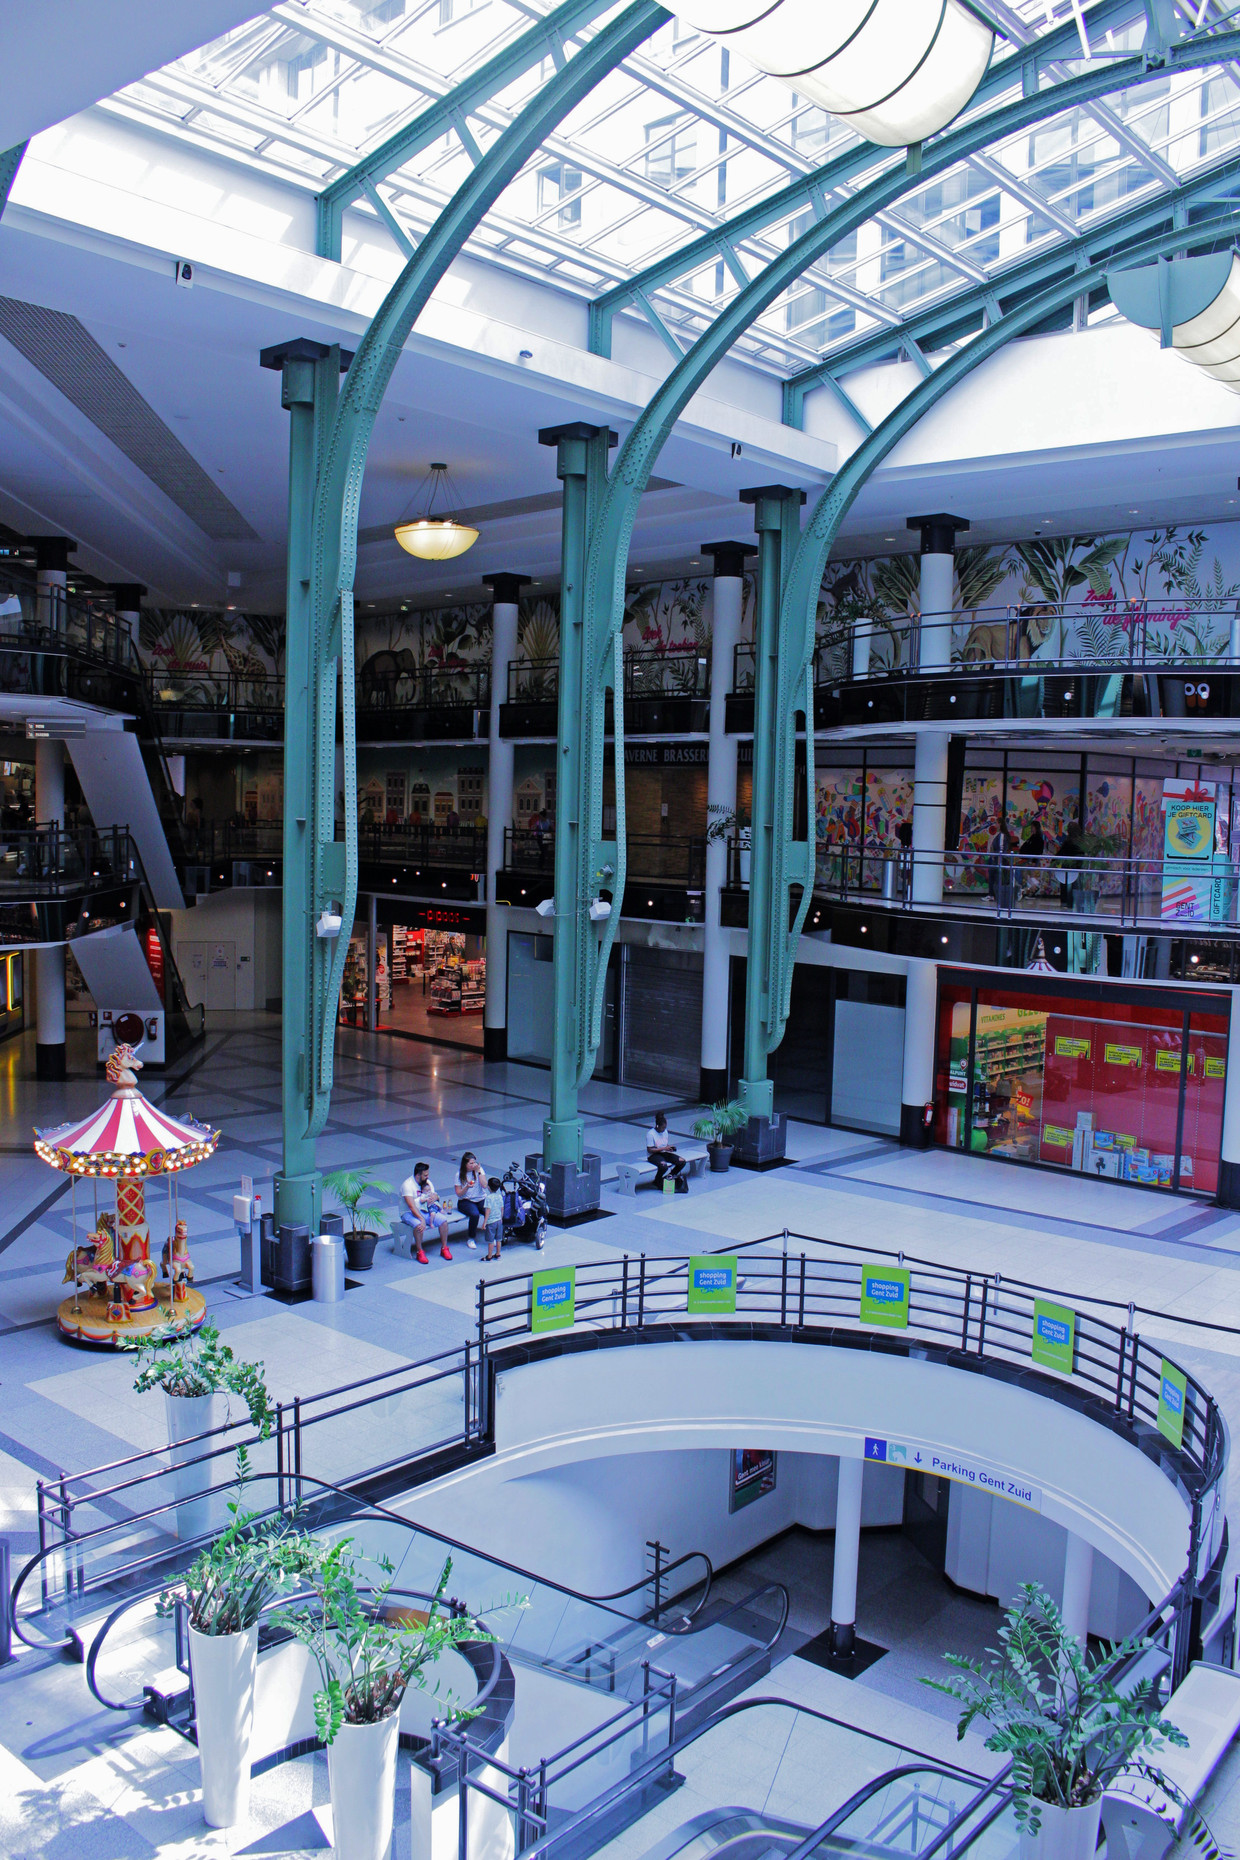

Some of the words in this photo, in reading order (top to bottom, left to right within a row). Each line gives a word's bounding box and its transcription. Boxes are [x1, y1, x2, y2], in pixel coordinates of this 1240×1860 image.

[1081, 587, 1114, 607] Zoek
[624, 750, 658, 762] AVERNE
[664, 749, 709, 762] BRASSER
[1212, 878, 1222, 915] GIFTCARD
[701, 1272, 726, 1280] shopping
[542, 1286, 566, 1295] shopping
[872, 1282, 898, 1292] shopping
[554, 1292, 566, 1300] Zuid
[872, 1289, 885, 1297] Gent
[886, 1290, 898, 1298] Zuid
[932, 1457, 976, 1481] Parking
[979, 1472, 1006, 1490] Gent
[1007, 1483, 1032, 1501] Zuid
